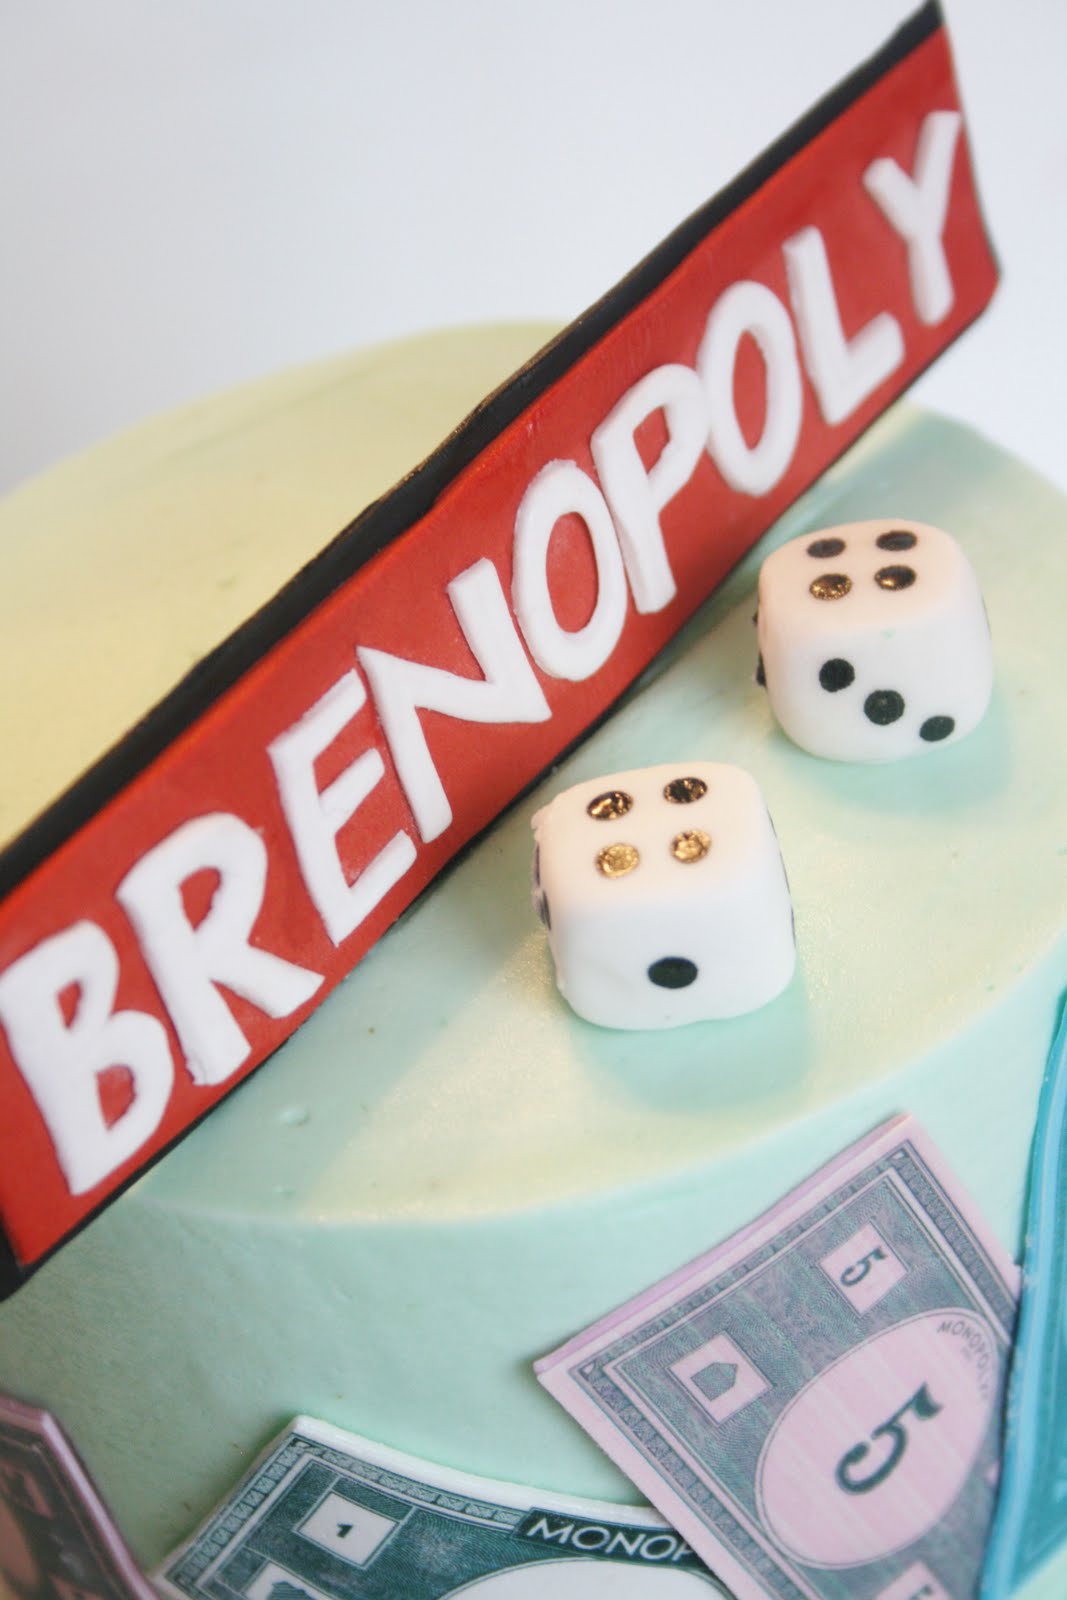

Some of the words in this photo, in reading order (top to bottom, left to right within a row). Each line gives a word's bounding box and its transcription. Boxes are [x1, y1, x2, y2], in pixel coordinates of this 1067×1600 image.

[0, 110, 963, 1196] BRENOPOLY
[841, 1246, 887, 1287] 5
[836, 1382, 944, 1495] 5
[336, 1523, 353, 1538] 1
